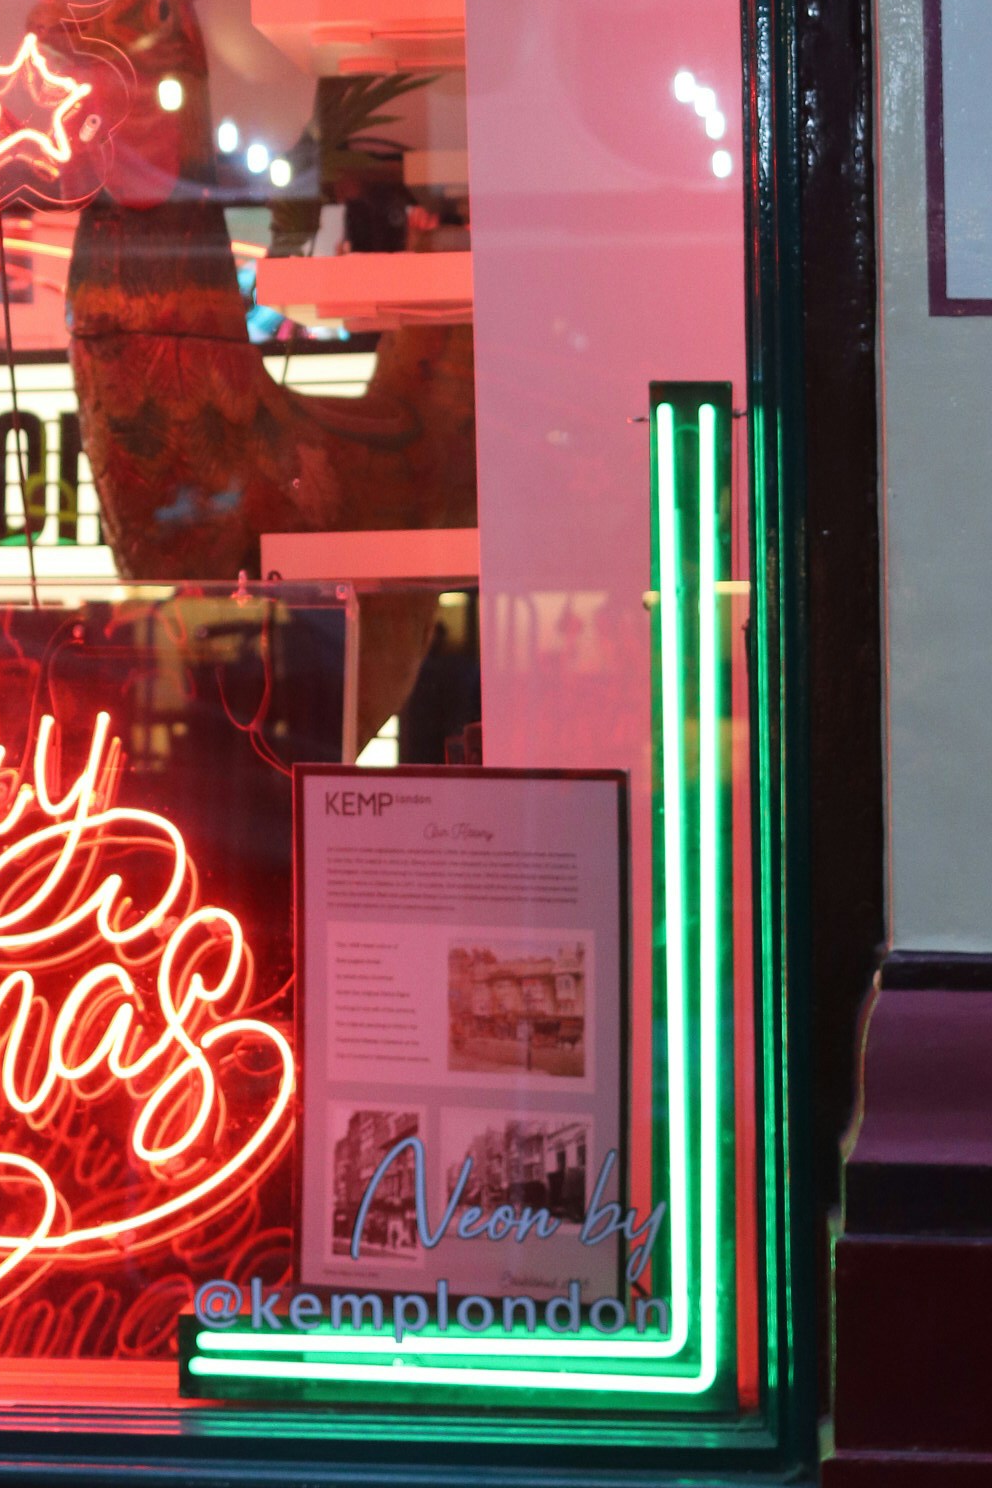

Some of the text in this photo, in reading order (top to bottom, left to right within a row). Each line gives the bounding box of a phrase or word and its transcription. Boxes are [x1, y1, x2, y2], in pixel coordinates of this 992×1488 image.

[325, 791, 394, 816] KEMP
[351, 1136, 667, 1282] Neon by
[194, 1277, 670, 1344] @kemplondon
